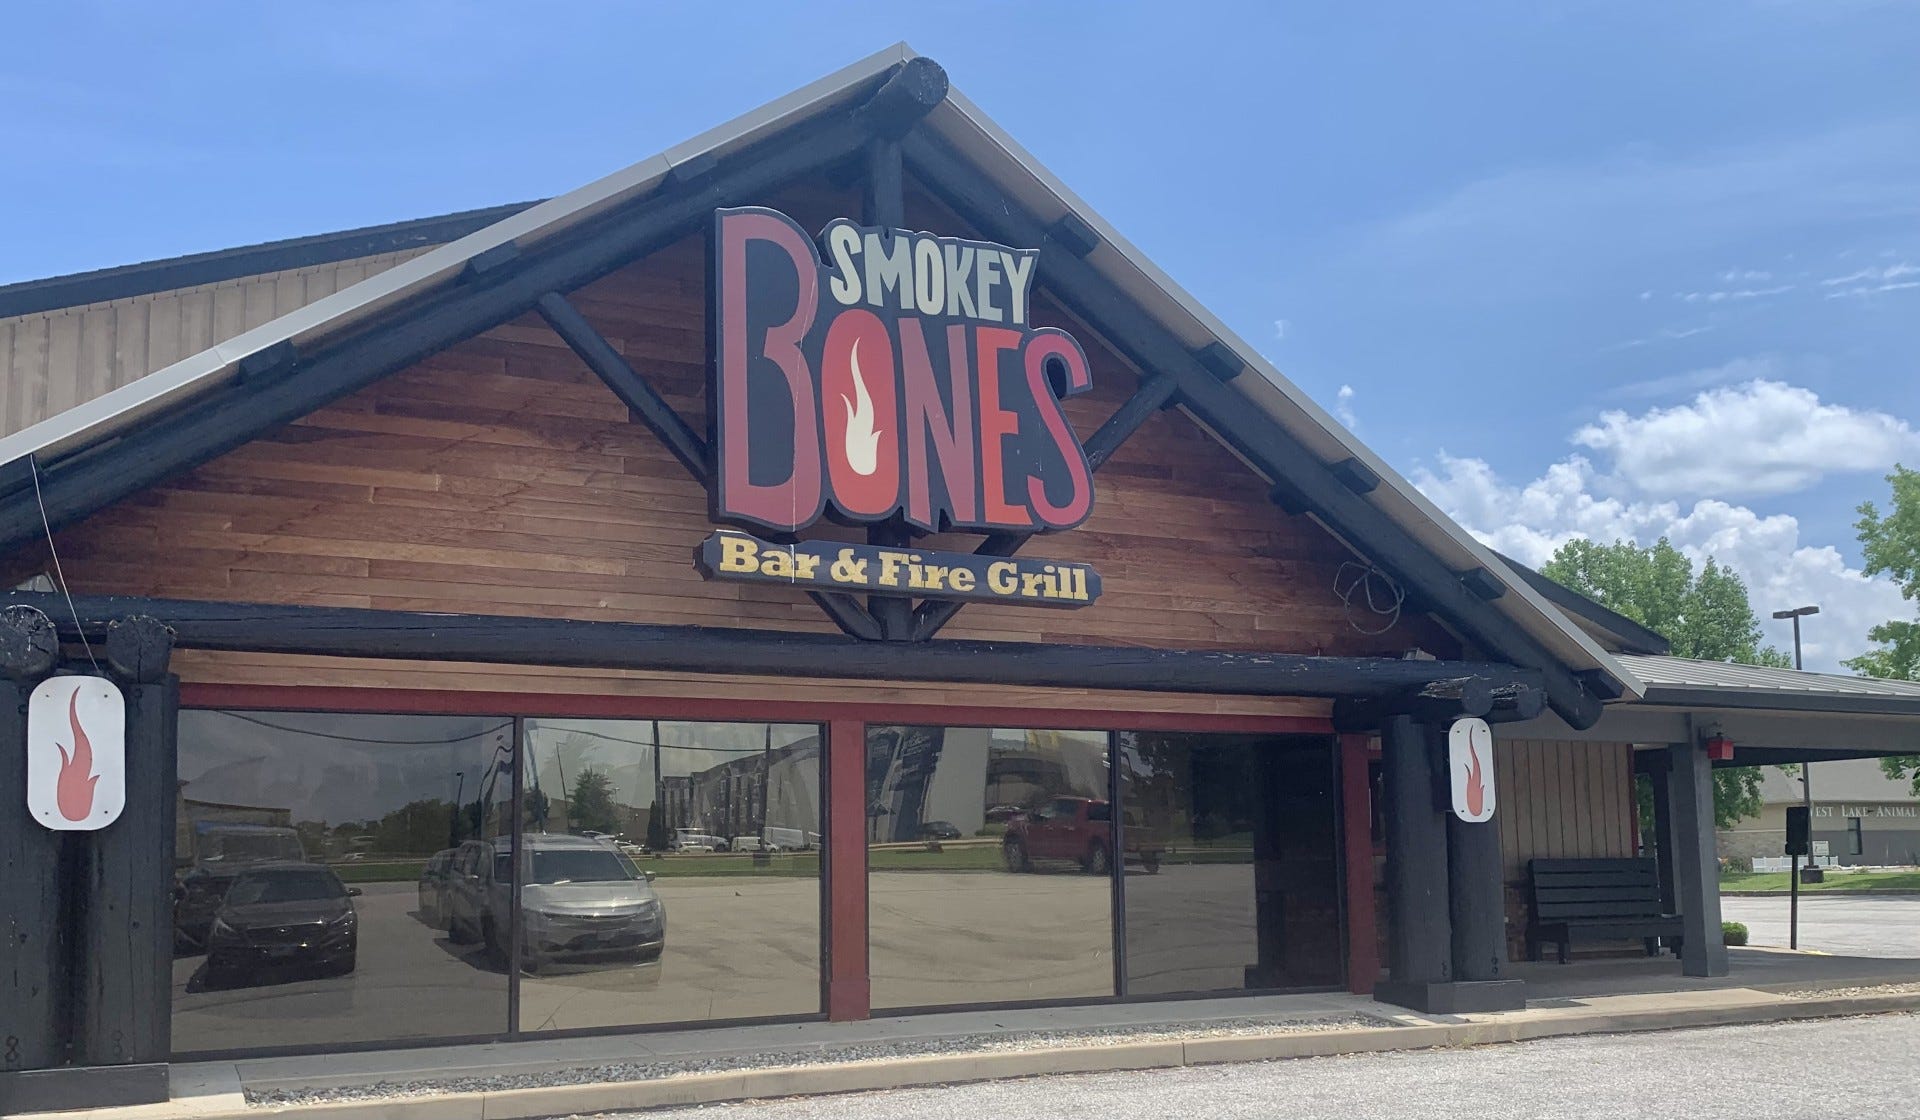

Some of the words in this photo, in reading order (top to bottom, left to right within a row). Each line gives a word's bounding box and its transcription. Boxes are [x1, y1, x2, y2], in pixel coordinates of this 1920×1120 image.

[829, 224, 1034, 324] SMOKEY
[721, 213, 1091, 527] BONES
[719, 536, 820, 579] Bar
[830, 548, 868, 584] &
[878, 551, 976, 592] Fire
[987, 561, 1089, 600] Grill
[1811, 805, 1834, 817] EST
[1841, 804, 1869, 817] LAKE
[1876, 805, 1918, 818] ANIMAL
